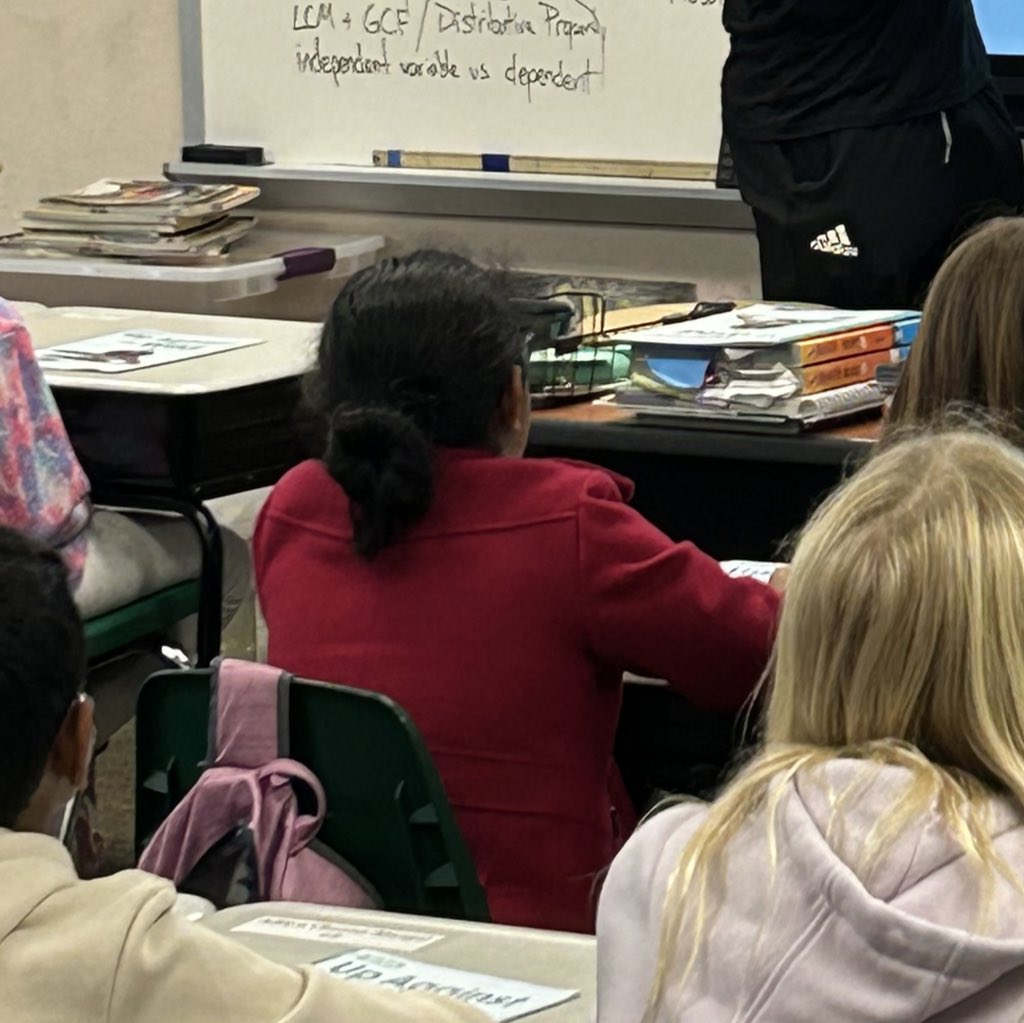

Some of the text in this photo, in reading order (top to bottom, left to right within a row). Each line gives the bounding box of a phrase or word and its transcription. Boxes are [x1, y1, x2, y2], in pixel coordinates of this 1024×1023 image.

[292, 2, 335, 31] LCM
[362, 2, 409, 36] GCF
[295, 36, 391, 87] independent
[468, 62, 491, 81] vs
[504, 52, 598, 104] dependent
